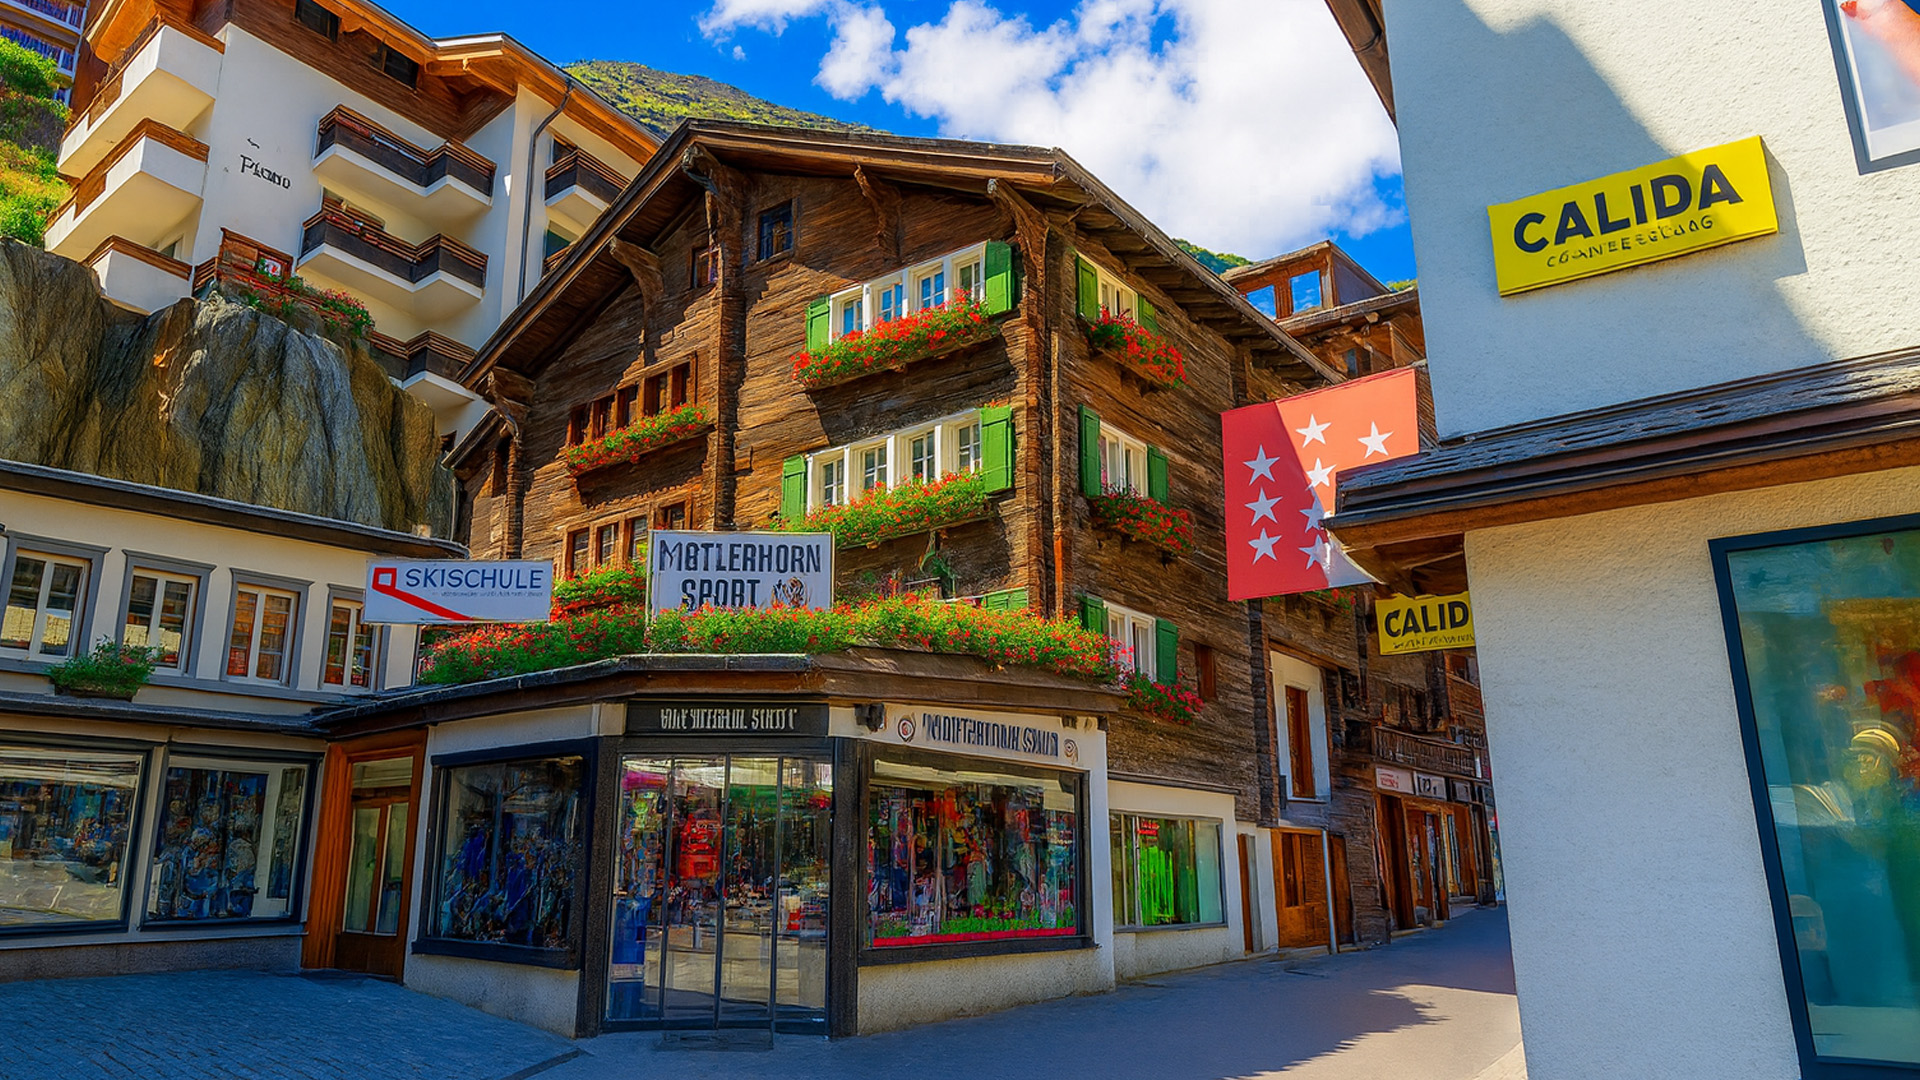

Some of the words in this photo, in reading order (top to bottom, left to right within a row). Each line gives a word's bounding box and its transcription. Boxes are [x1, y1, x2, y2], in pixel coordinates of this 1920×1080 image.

[1513, 164, 1744, 253] CALIDA
[405, 568, 544, 589] SKISCHULE
[681, 578, 761, 611] SPORT
